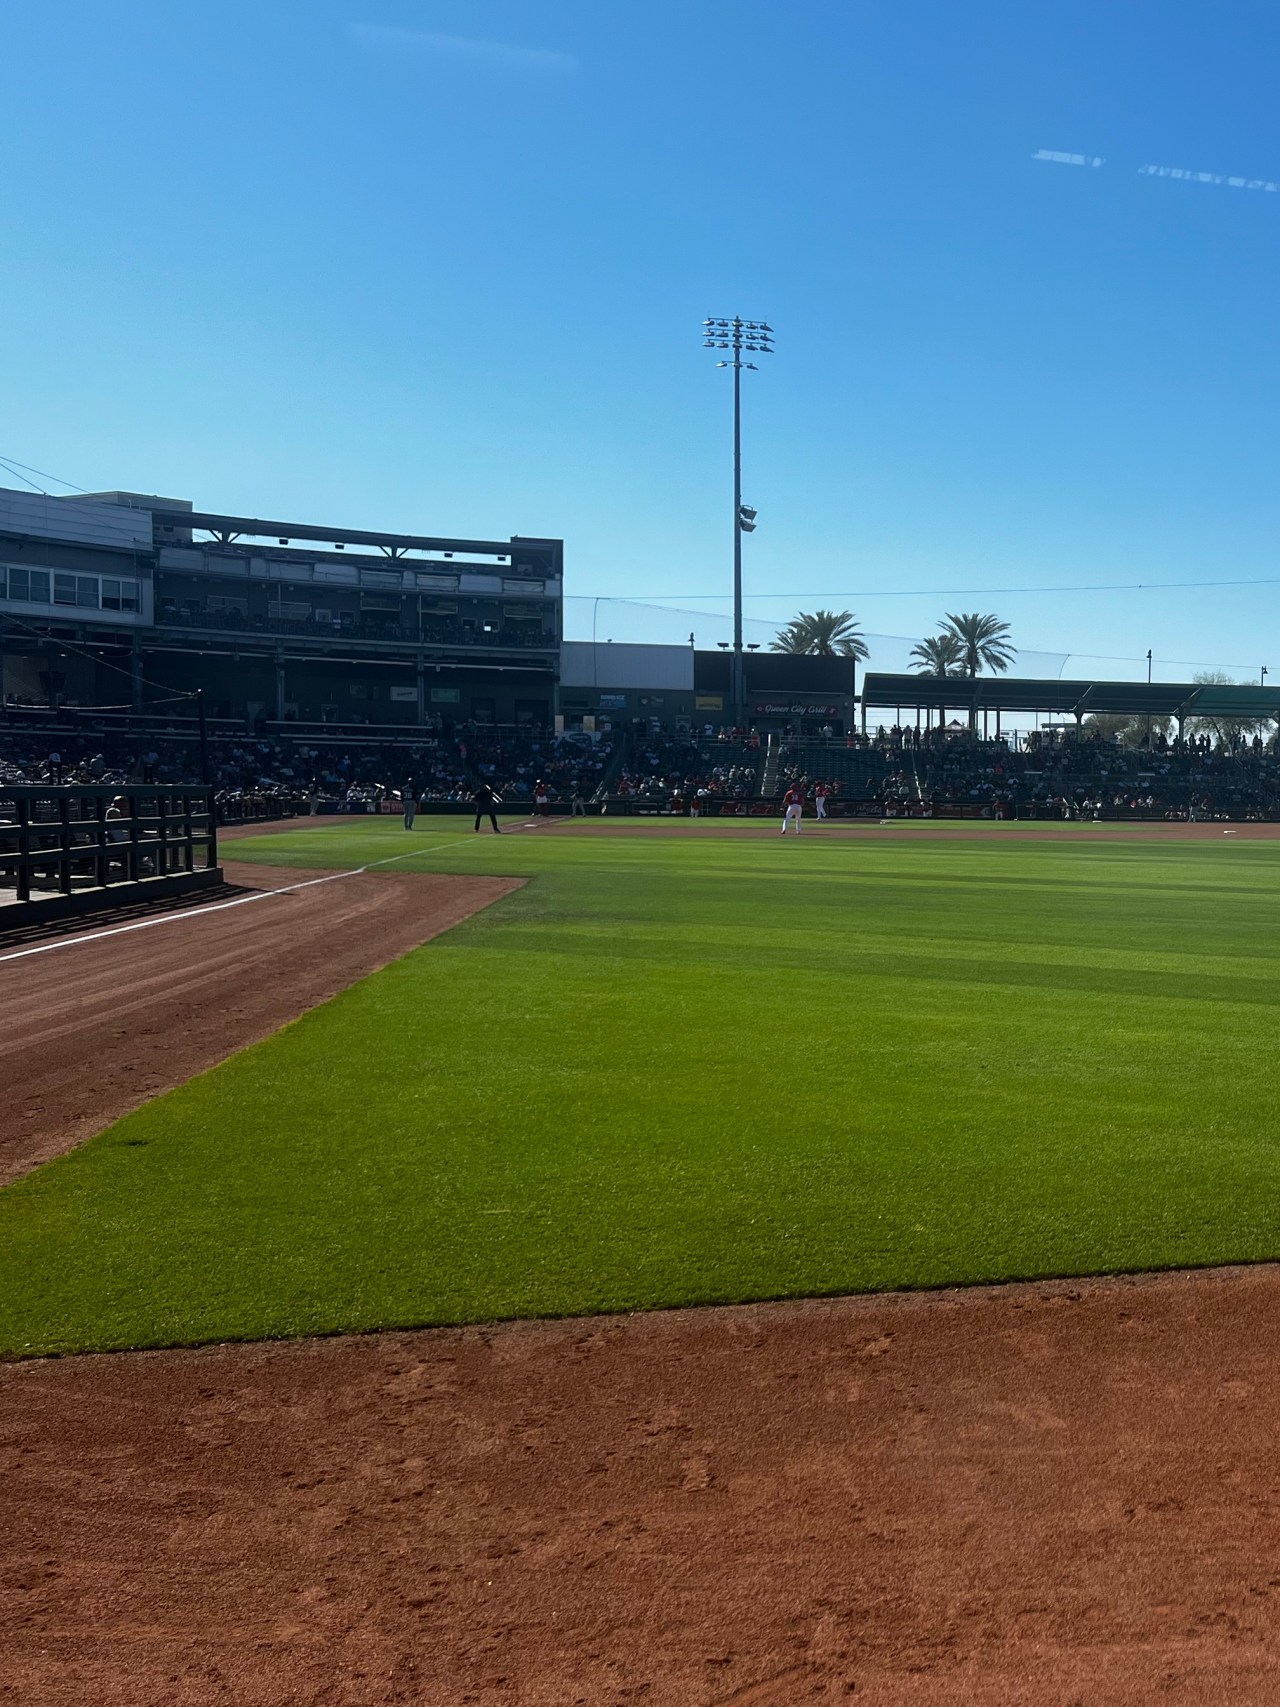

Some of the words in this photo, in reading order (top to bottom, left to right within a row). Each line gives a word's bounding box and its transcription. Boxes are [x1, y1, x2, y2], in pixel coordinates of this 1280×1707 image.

[765, 704, 788, 713] Queen
[791, 704, 806, 716] City
[808, 705, 828, 714] Grill
